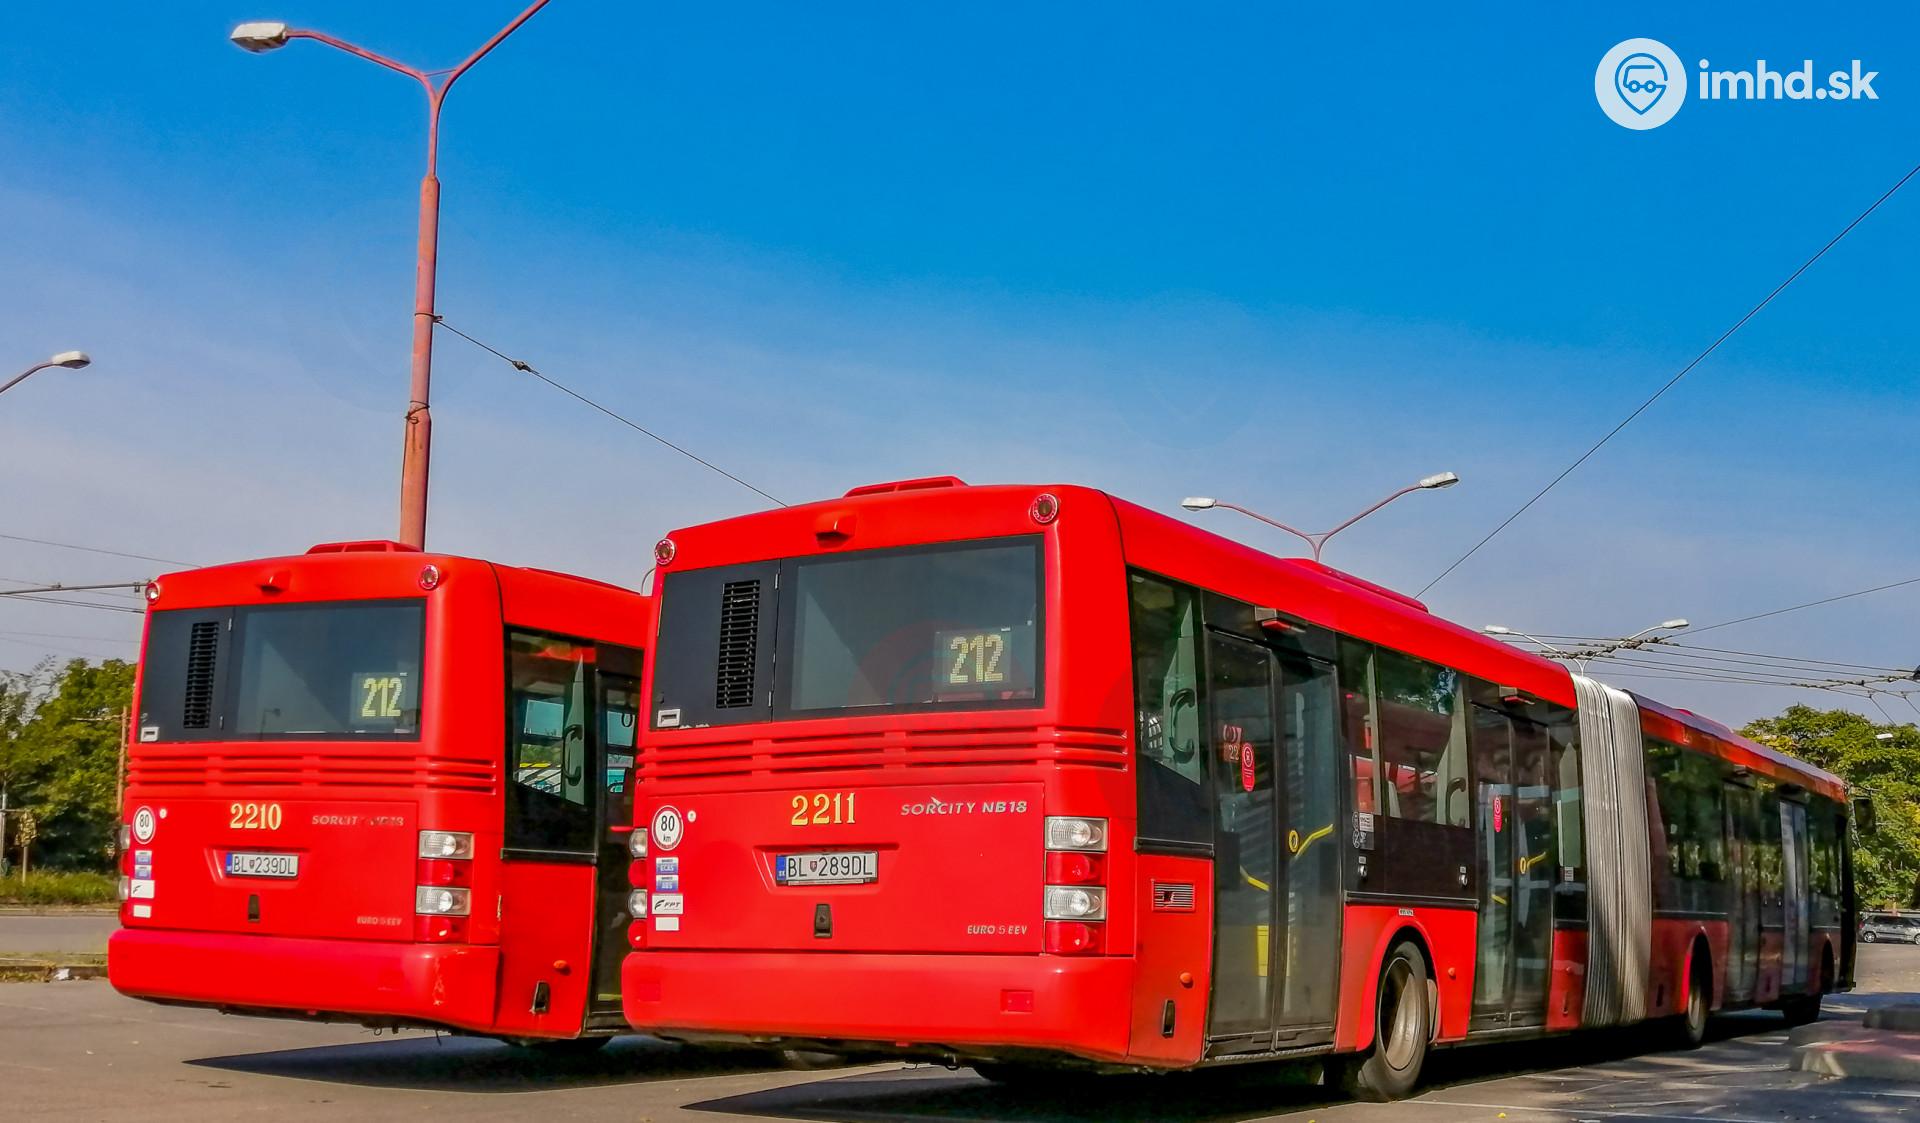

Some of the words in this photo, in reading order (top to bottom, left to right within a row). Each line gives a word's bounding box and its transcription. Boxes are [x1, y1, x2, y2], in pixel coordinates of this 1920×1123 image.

[950, 634, 1003, 683] 212
[362, 677, 402, 717] 212
[229, 803, 282, 830] 2210
[791, 792, 856, 826] 2211
[982, 800, 1028, 814] NB18
[139, 814, 150, 828] 80
[660, 815, 675, 832] 80
[233, 856, 248, 873] BL
[255, 856, 295, 875] 239DL
[788, 857, 807, 878] BL
[818, 855, 873, 877] 289DL
[967, 925, 996, 935] EURO
[999, 925, 1006, 935] 5
[1008, 925, 1028, 935] EEV
